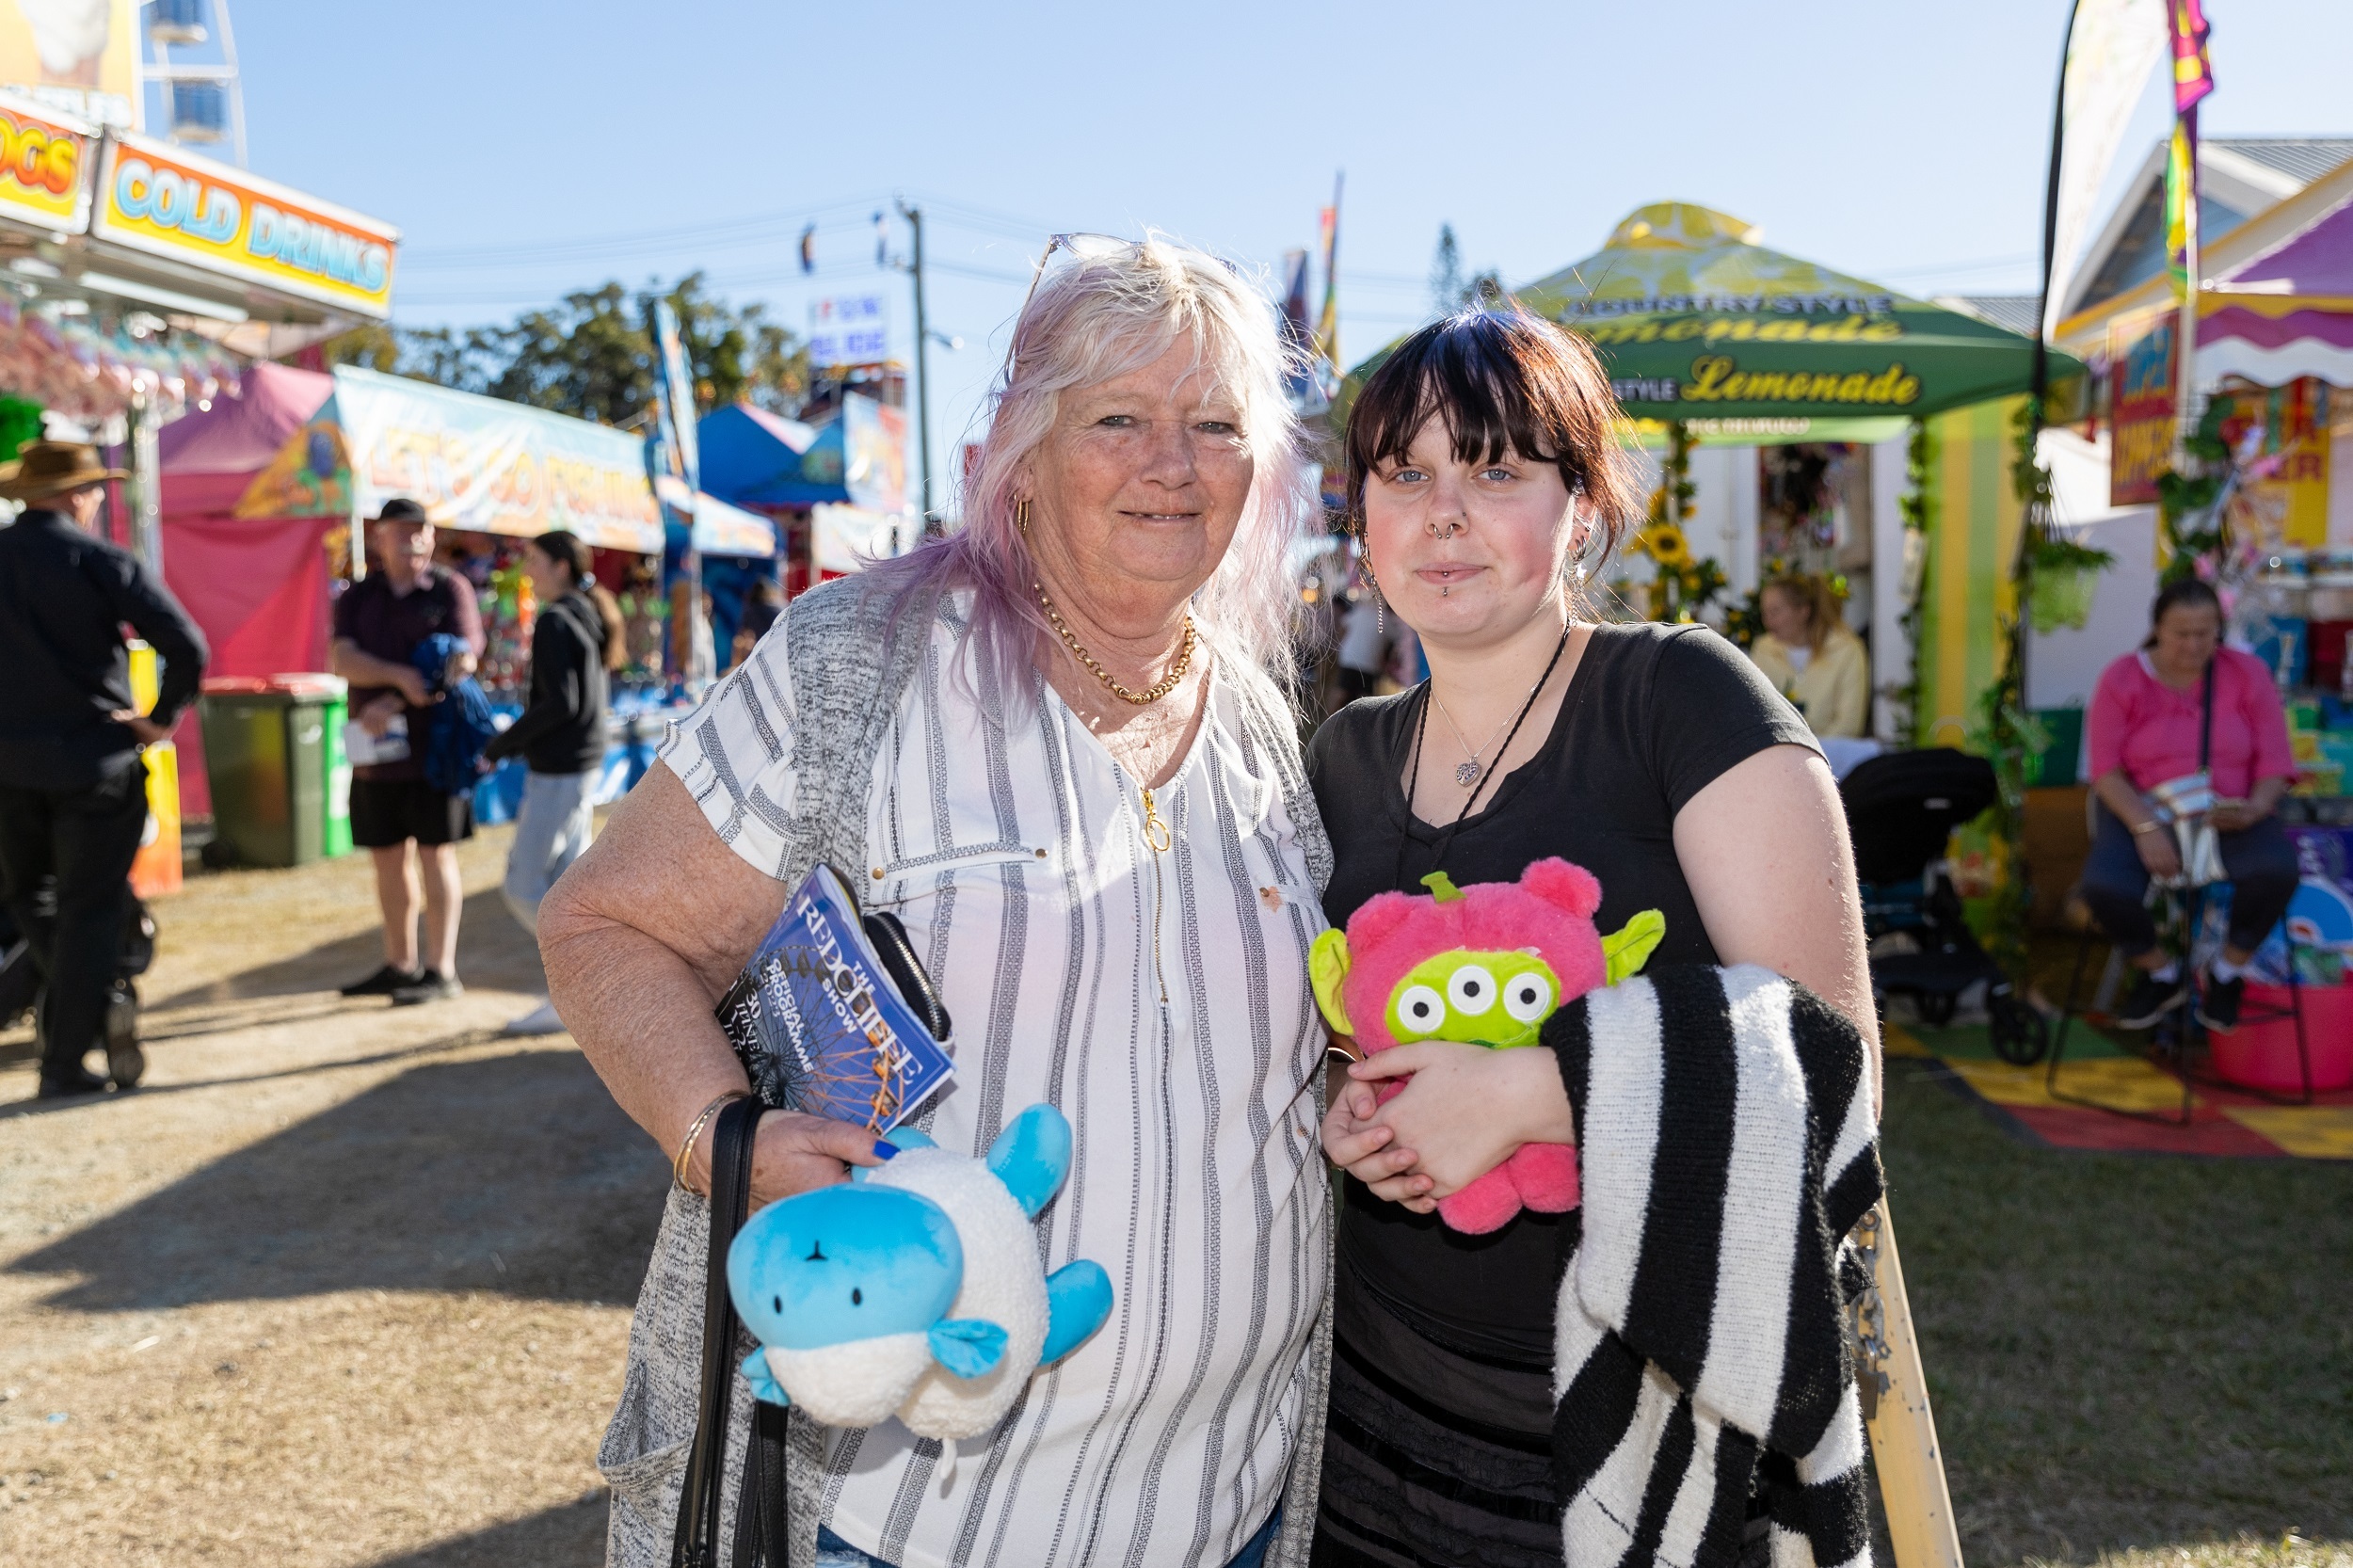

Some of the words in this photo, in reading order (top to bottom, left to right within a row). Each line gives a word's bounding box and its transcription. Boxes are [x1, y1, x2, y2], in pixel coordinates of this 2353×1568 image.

[114, 157, 241, 245] COLD
[247, 200, 390, 294] DRINKS
[1593, 313, 1903, 344] monade
[1772, 293, 1893, 314] STYLE
[1679, 354, 1922, 406] Lemonade
[759, 972, 781, 1018] 2023
[772, 958, 806, 1034] OFFICIAL
[797, 894, 924, 1086] REDCLIFFE
[853, 960, 876, 994] THE
[735, 1001, 760, 1051] JUNE
[745, 987, 762, 1019] 30
[766, 965, 814, 1074] PROGRAMME
[822, 977, 858, 1034] SHOW
